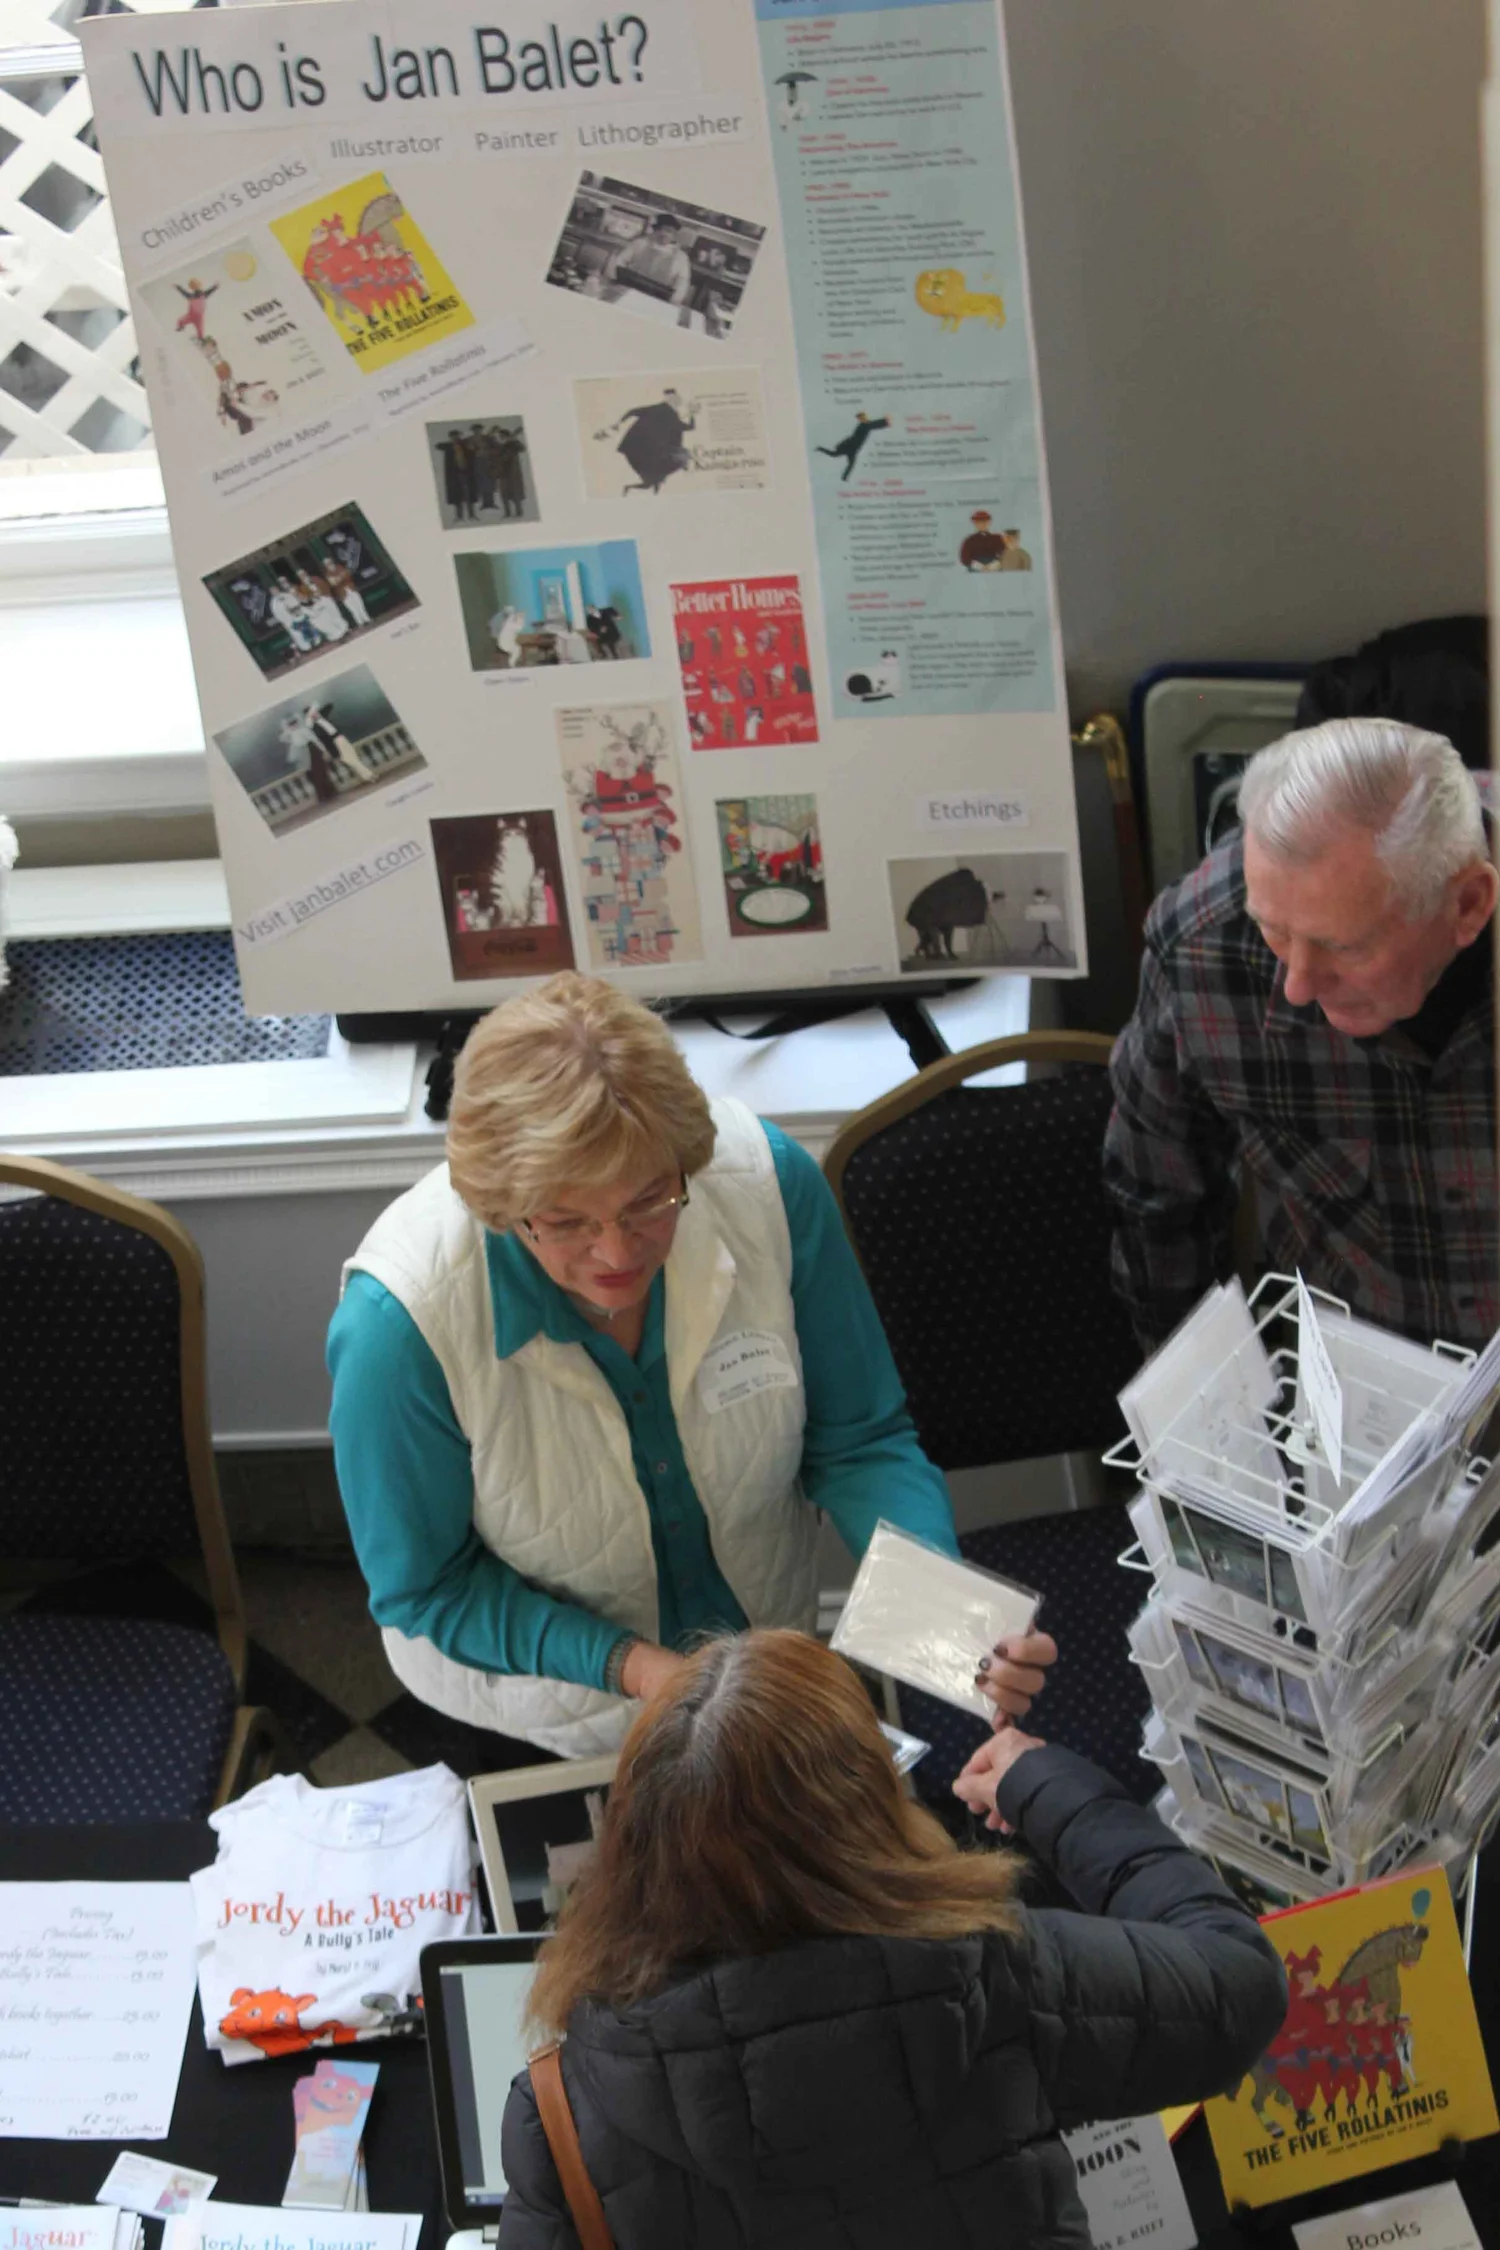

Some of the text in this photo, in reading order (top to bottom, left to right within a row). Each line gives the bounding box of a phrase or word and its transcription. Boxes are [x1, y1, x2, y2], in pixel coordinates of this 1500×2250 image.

[133, 14, 648, 117] Who is Jan Balet?
[330, 133, 443, 159] Illustrator
[475, 127, 559, 152] Painter
[578, 113, 742, 149] Lithographer
[142, 161, 307, 249] Children's Books
[928, 800, 1022, 822] Etchings
[238, 840, 422, 943] Visit janbalet.com
[217, 1888, 473, 1937] Jordy the Jaguar
[304, 1926, 394, 1949] A Bully's Tale
[1243, 2089, 1449, 2171] THE FIVE ROLLATINIS
[264, 2235, 297, 2250] the
[1346, 2220, 1422, 2250] Books
